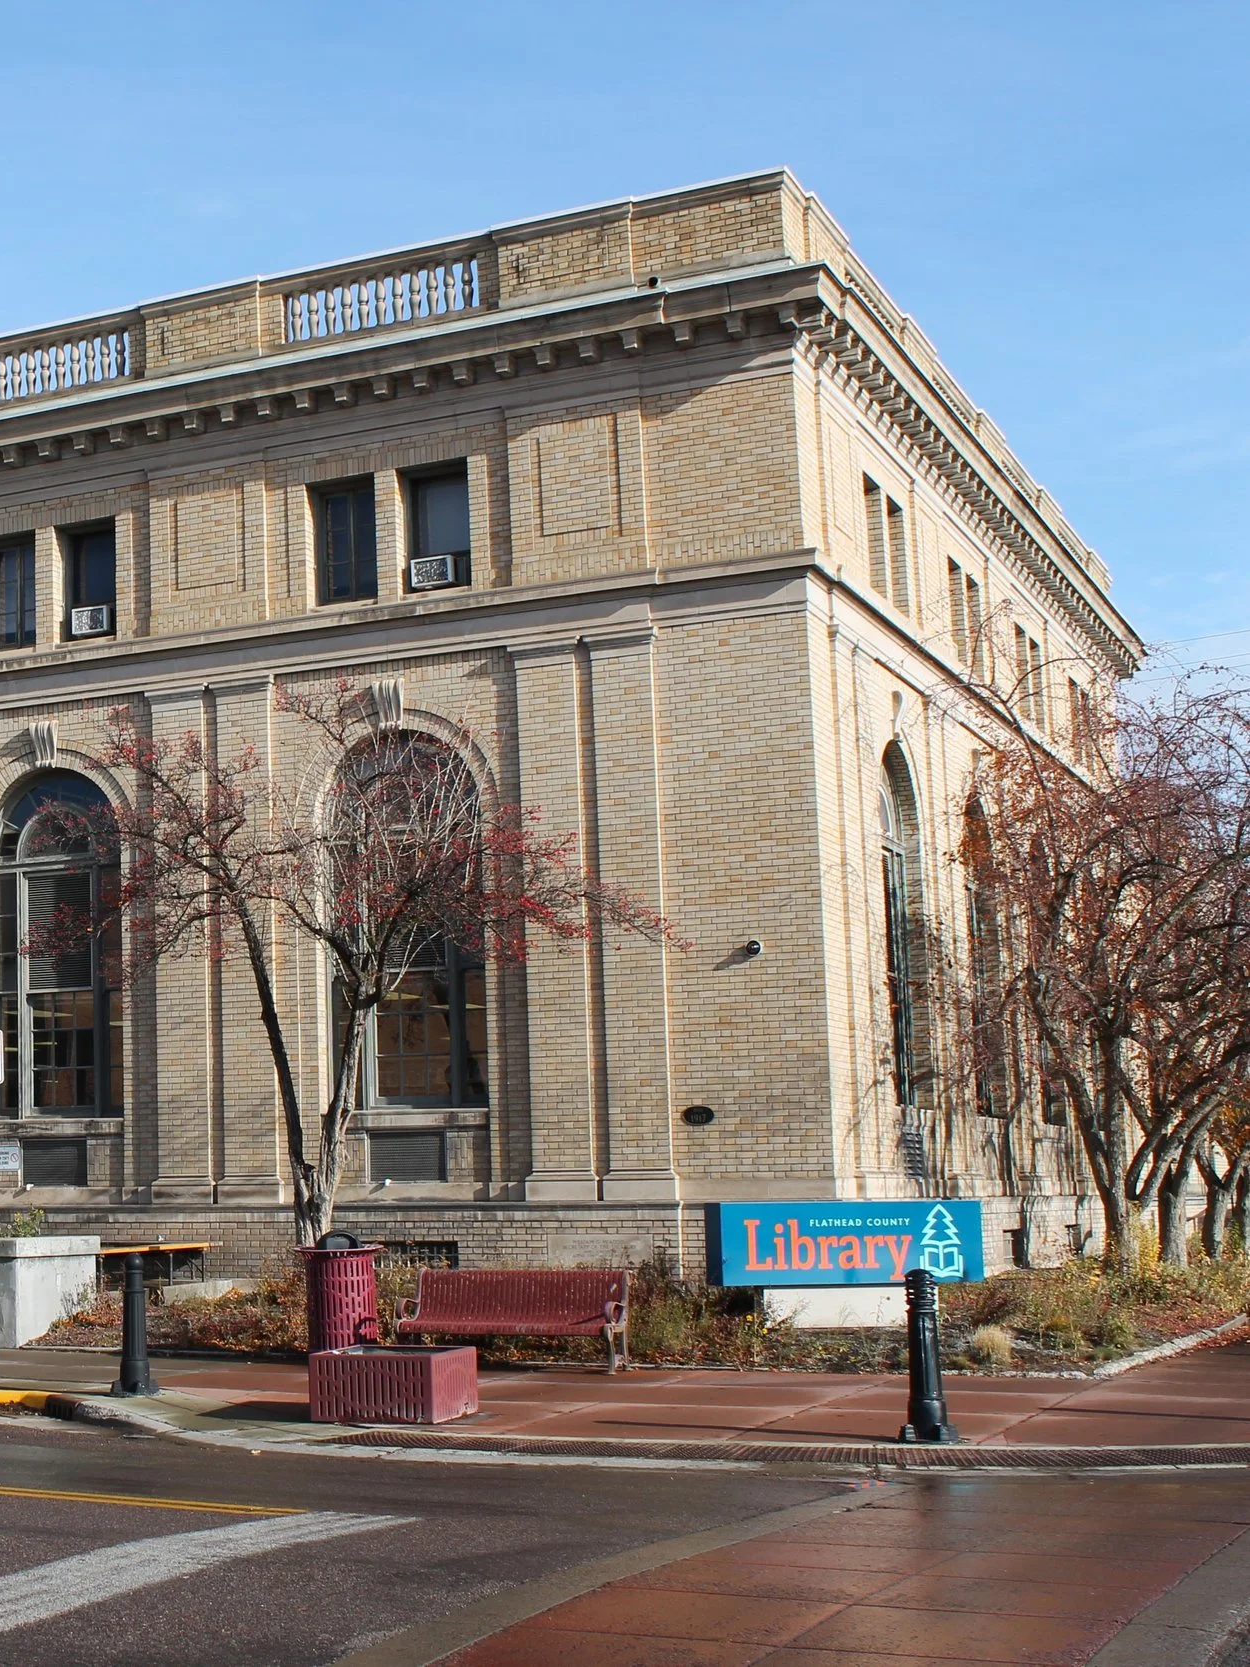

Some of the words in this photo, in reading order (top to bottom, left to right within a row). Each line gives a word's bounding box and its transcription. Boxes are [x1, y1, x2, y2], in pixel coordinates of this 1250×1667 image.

[809, 1218, 862, 1227] FLATHEAD
[866, 1217, 911, 1227] COUNTY
[743, 1218, 913, 1281] Library
